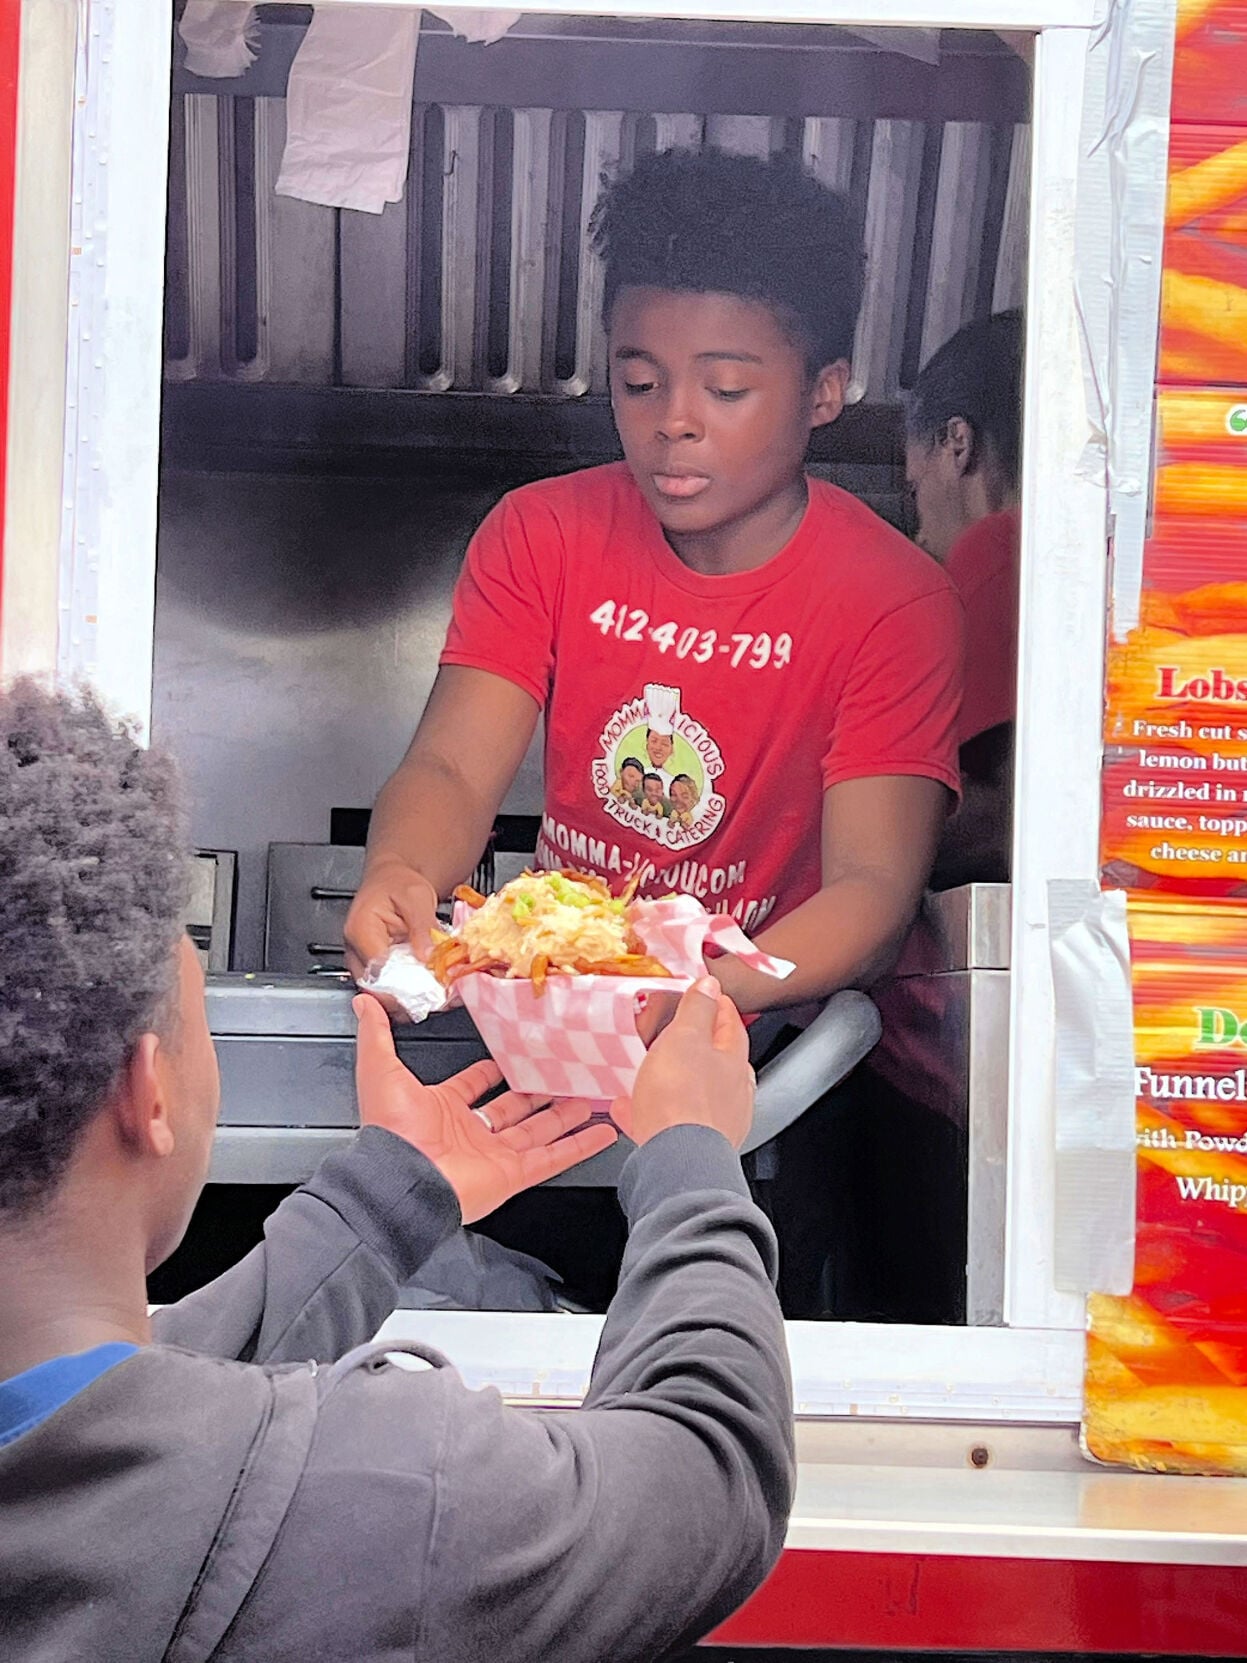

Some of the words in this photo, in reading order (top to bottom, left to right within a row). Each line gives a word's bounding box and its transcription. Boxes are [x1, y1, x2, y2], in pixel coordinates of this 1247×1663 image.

[1132, 719, 1192, 739] Fresh
[1198, 724, 1232, 740] cut
[1139, 749, 1207, 770] lemon
[1123, 779, 1210, 801] drizzled
[1216, 783, 1237, 802] in
[607, 799, 651, 833] TRUCK
[665, 797, 724, 845] CATERING
[1126, 814, 1193, 831] sauce,
[1150, 842, 1223, 862] cheese
[1196, 1007, 1247, 1045] D
[1135, 1066, 1247, 1101] Funnel
[1175, 1175, 1247, 1209] Whip
